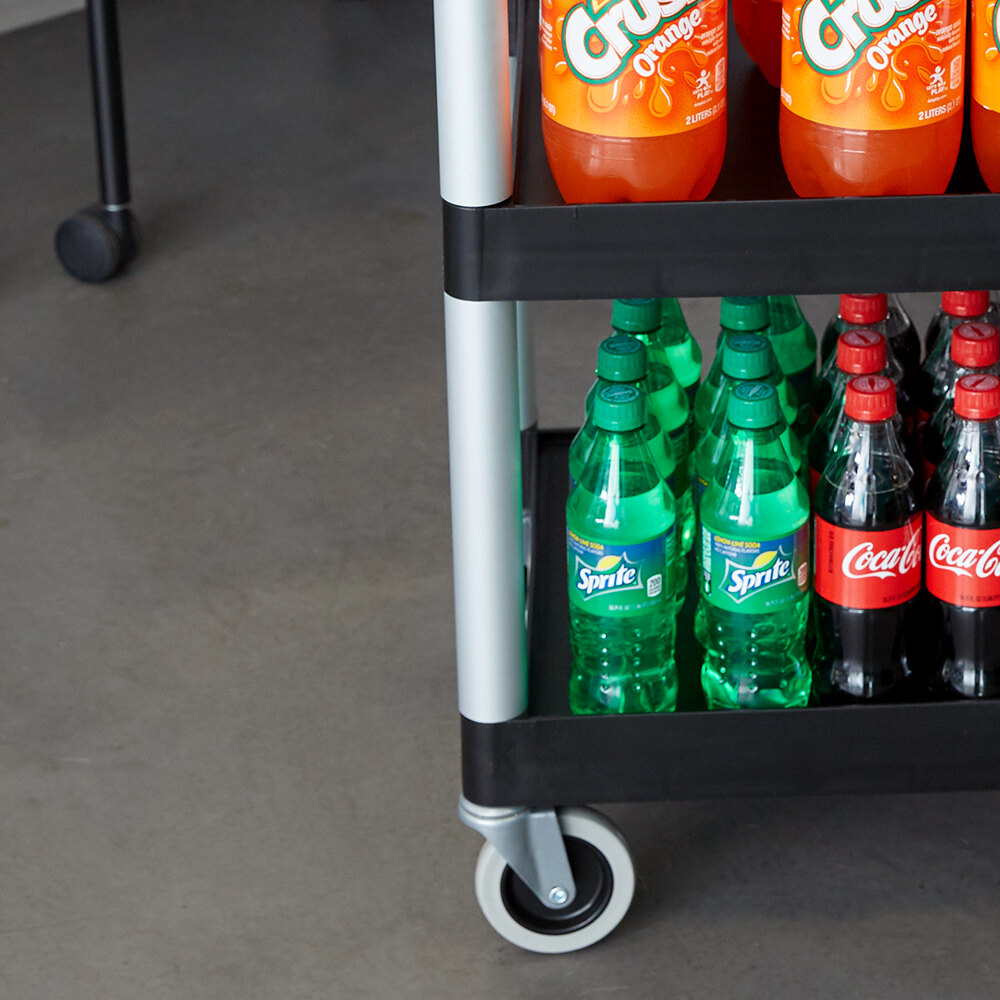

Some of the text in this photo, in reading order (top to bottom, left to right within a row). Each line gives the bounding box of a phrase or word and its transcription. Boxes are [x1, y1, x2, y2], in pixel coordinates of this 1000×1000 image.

[631, 7, 703, 78] Orange
[866, 3, 938, 72] Orange
[685, 116, 691, 125] 2
[691, 108, 712, 123] LITERS
[918, 111, 924, 121] 2
[924, 104, 947, 119] LITERS
[577, 563, 636, 594] Sprite
[728, 557, 790, 596] Sprite
